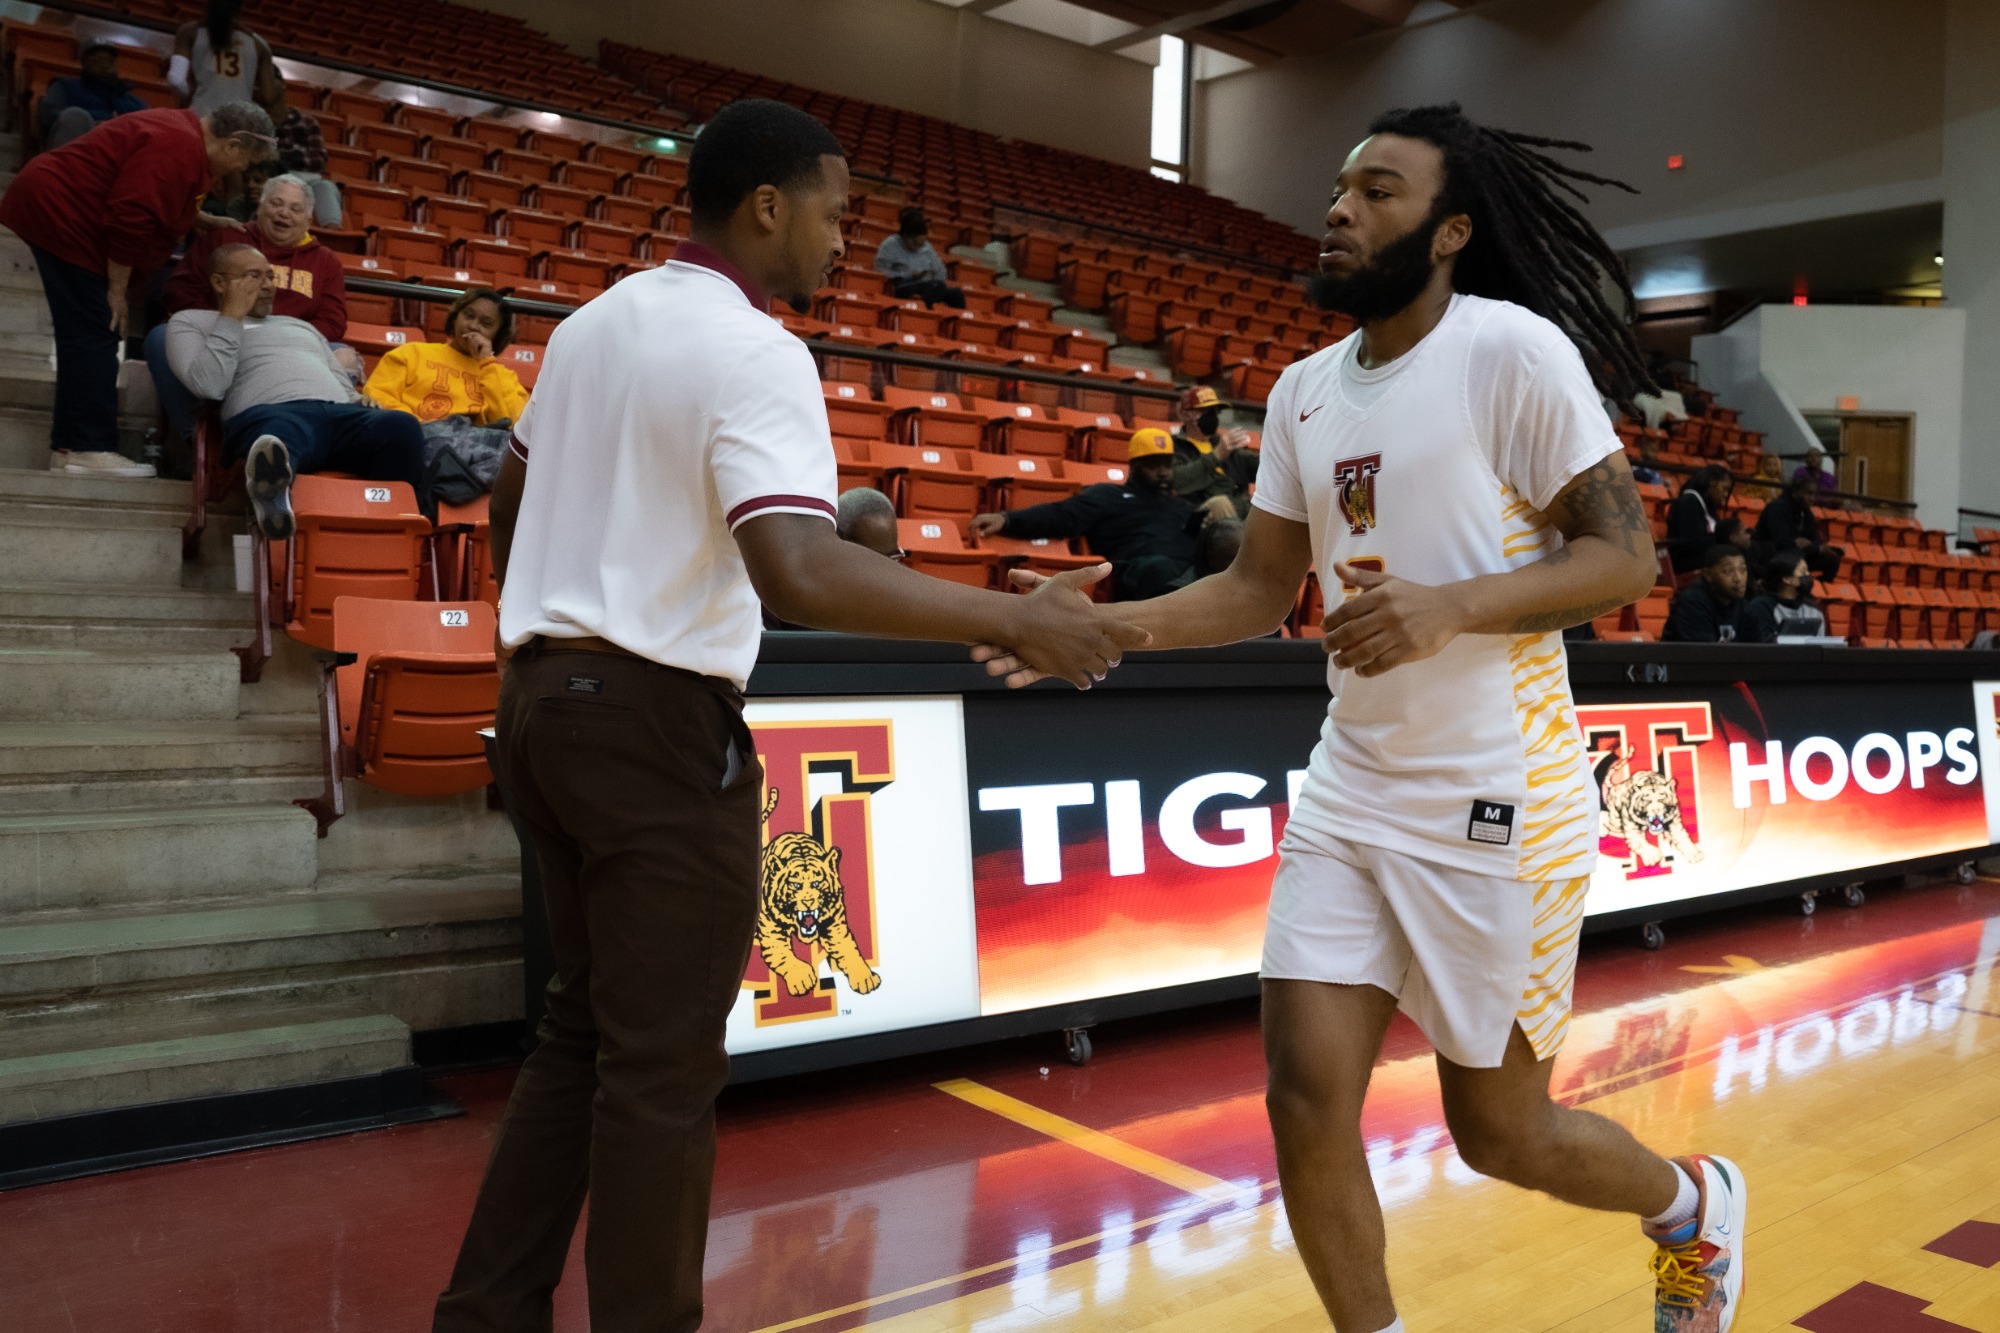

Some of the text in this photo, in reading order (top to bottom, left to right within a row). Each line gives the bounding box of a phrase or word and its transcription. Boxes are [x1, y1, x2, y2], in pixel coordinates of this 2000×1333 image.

[215, 51, 240, 77] 13
[370, 489, 386, 501] 22
[446, 611, 462, 625] 22
[1729, 728, 1978, 809] HOOPS
[1484, 806, 1501, 820] M
[978, 771, 1309, 886] TIG
